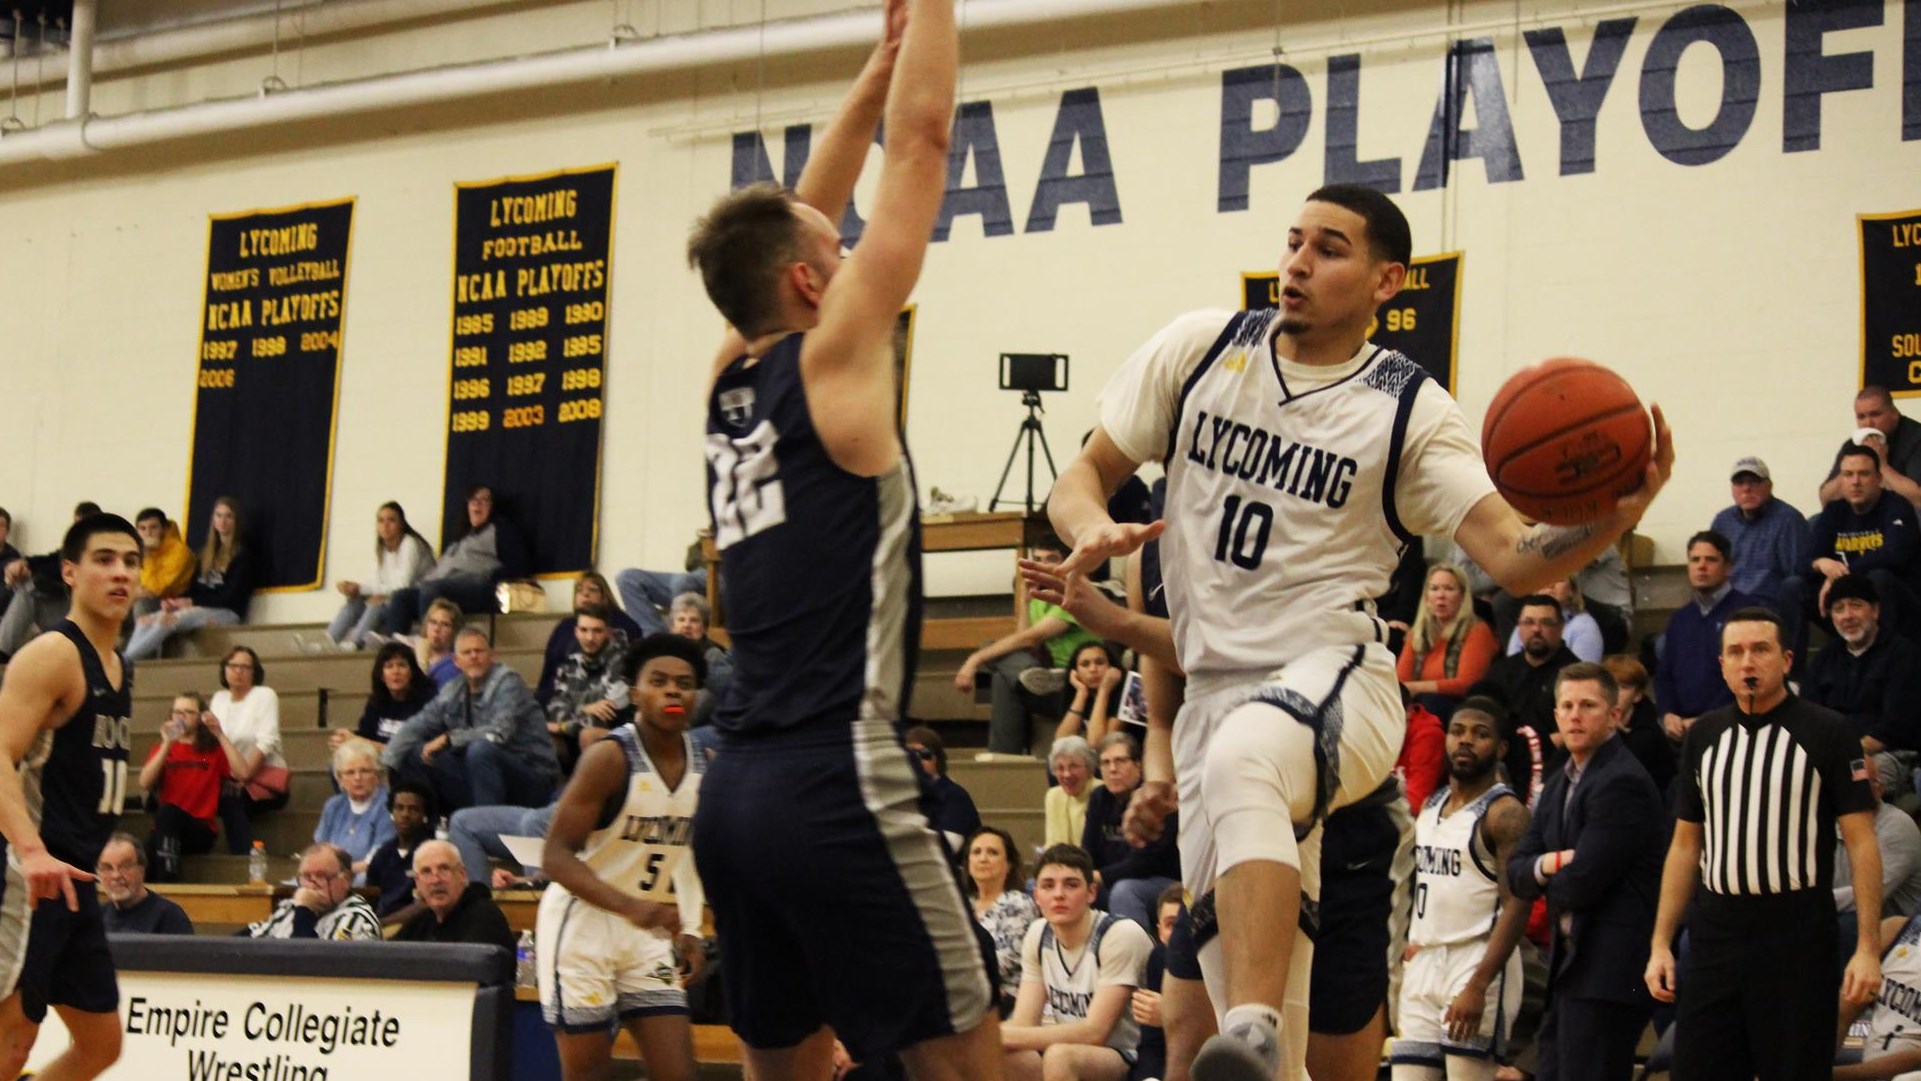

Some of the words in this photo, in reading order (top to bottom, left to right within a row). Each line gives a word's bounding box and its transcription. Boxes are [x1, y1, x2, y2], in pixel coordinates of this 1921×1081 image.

[731, 86, 1124, 252] NAA
[1217, 0, 1921, 213] PLAYOF
[490, 189, 578, 227] LYCOMING
[239, 223, 318, 258] LYCOMING
[482, 230, 583, 261] FOOTBALL
[211, 268, 260, 291] WOMEN'S
[269, 259, 340, 287] VOLLEYBALL
[458, 269, 507, 303] NCAA
[517, 259, 604, 297] PLAYOFFS
[208, 299, 252, 330] NCAA
[261, 289, 339, 326] PLAYOFFS
[565, 301, 604, 325] 1990
[203, 340, 238, 360] 1997
[300, 330, 339, 352] 2004
[455, 346, 487, 367] 1991
[508, 340, 547, 363] 1992
[563, 334, 602, 358] 1995
[199, 369, 235, 388] 2006
[454, 378, 490, 399] 1996
[507, 372, 546, 396] 1997
[562, 367, 601, 391] 1998
[452, 410, 490, 432] 1999
[502, 404, 545, 428] 2003
[558, 398, 601, 423] 2008
[1188, 410, 1358, 509] LYCOMING
[1215, 494, 1274, 571] 10
[126, 997, 229, 1047] Empire
[244, 1001, 400, 1055] Collegiate
